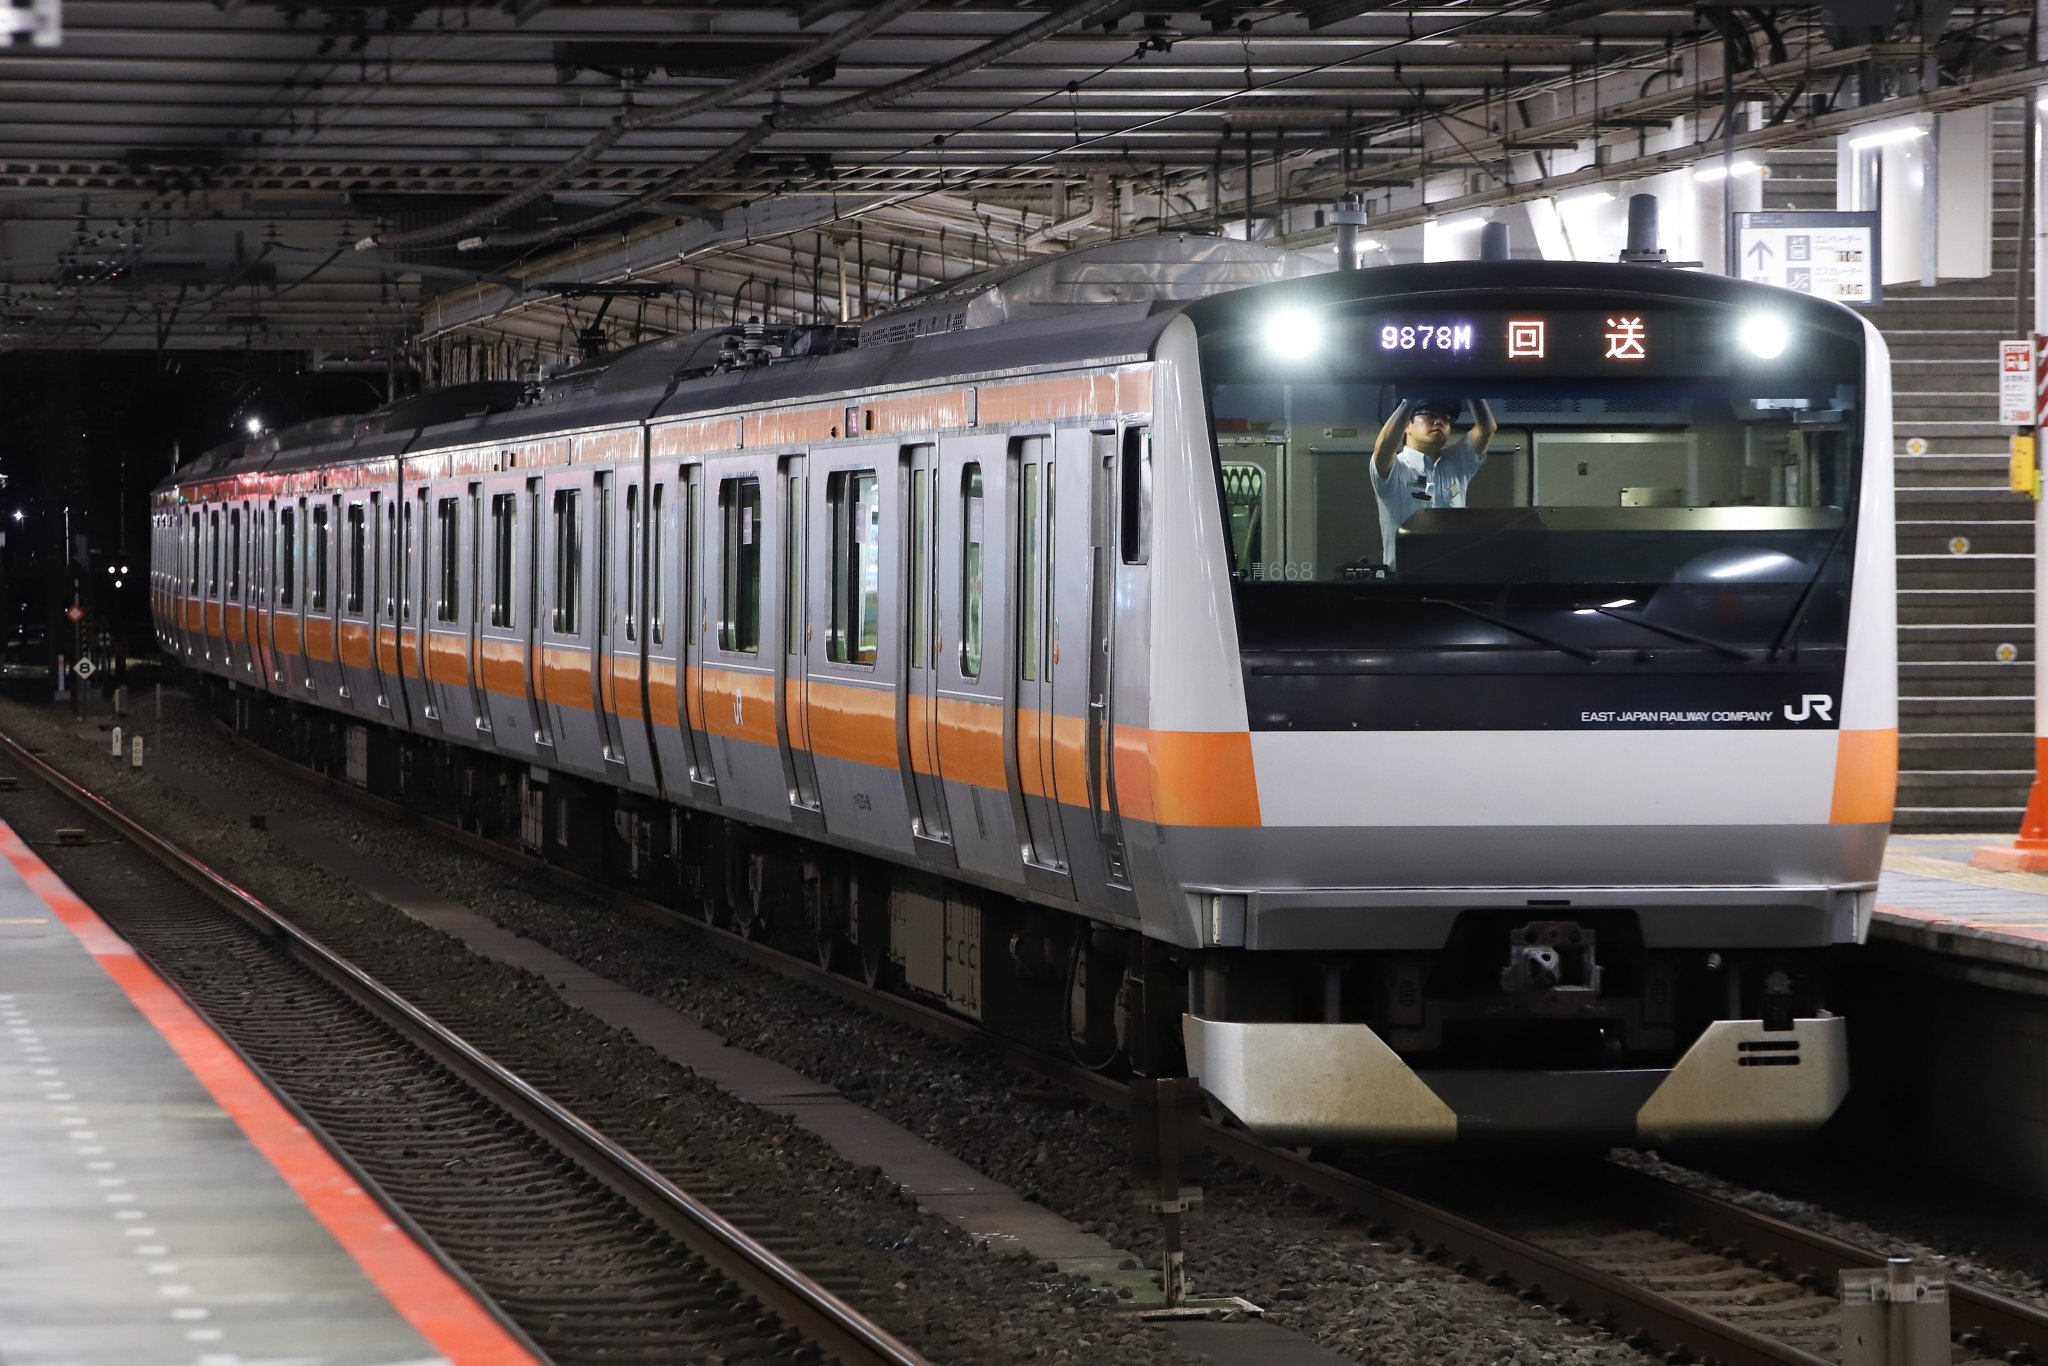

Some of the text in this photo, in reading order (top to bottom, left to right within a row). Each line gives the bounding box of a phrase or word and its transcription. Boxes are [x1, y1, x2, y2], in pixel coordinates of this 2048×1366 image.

[1381, 325, 1471, 350] 9878M
[1508, 316, 1646, 359] 回送
[79, 662, 91, 674] 8
[733, 688, 744, 726] JR
[1581, 711, 1773, 722] EAST JAPAN RAILWAY COMPANY
[1783, 694, 1833, 721] JR
